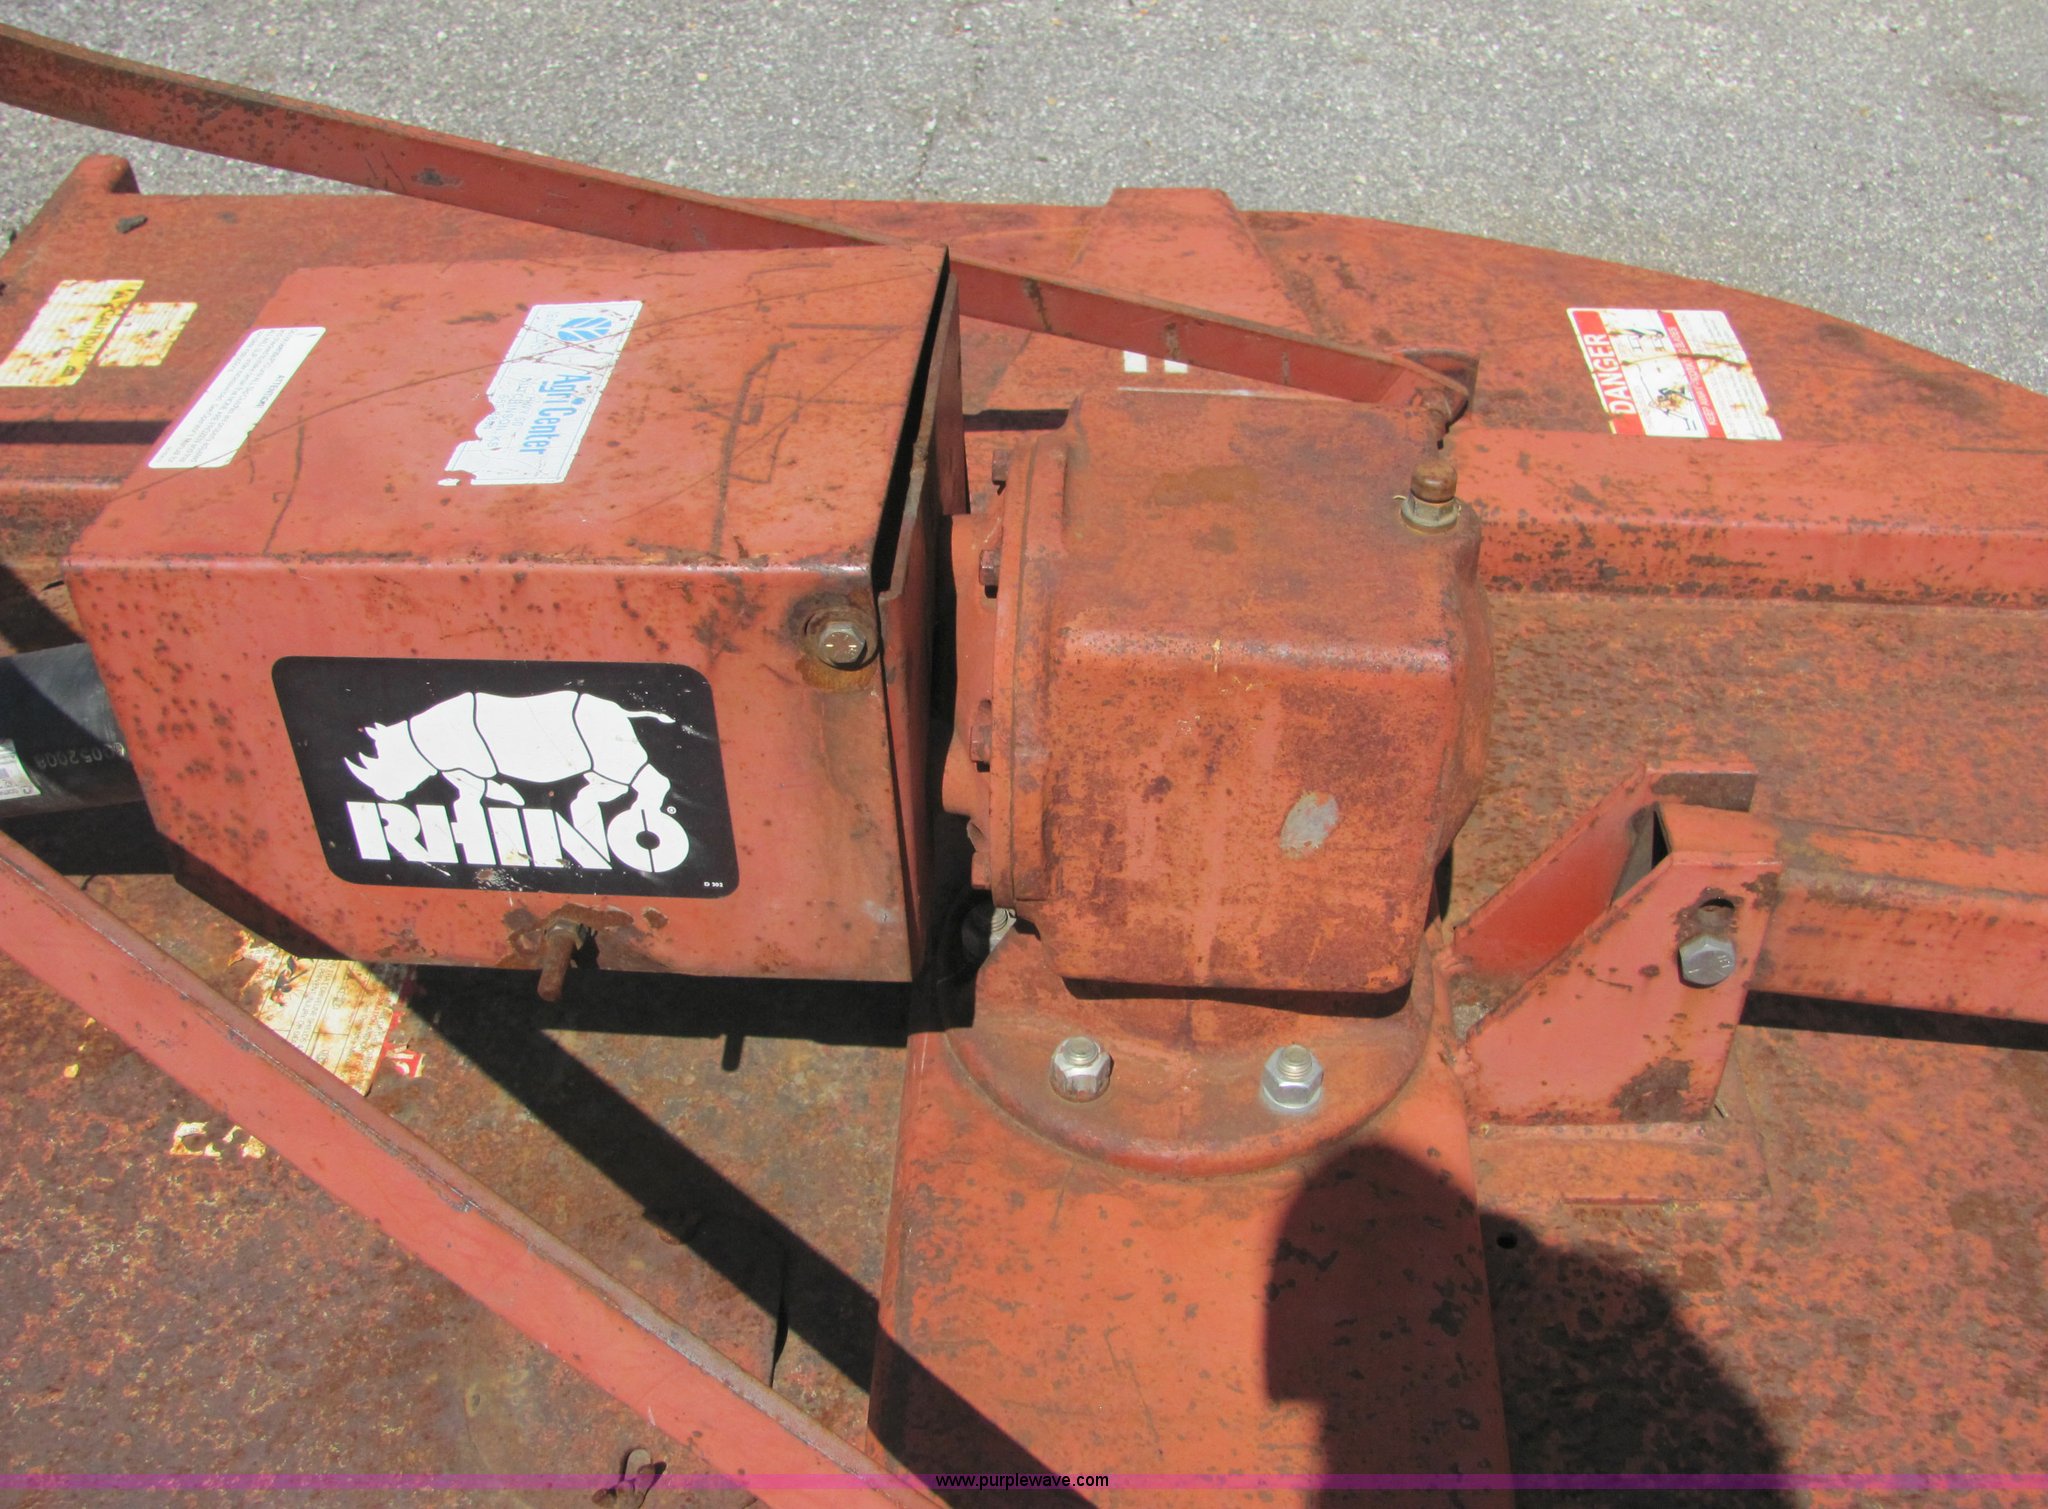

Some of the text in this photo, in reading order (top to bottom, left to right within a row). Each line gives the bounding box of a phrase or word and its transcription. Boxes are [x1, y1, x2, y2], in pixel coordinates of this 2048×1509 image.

[538, 374, 592, 405] Agri
[1583, 333, 1638, 414] DANGER
[519, 407, 577, 454] Center
[1701, 406, 1718, 426] KEEP
[346, 799, 690, 873] RHINO
